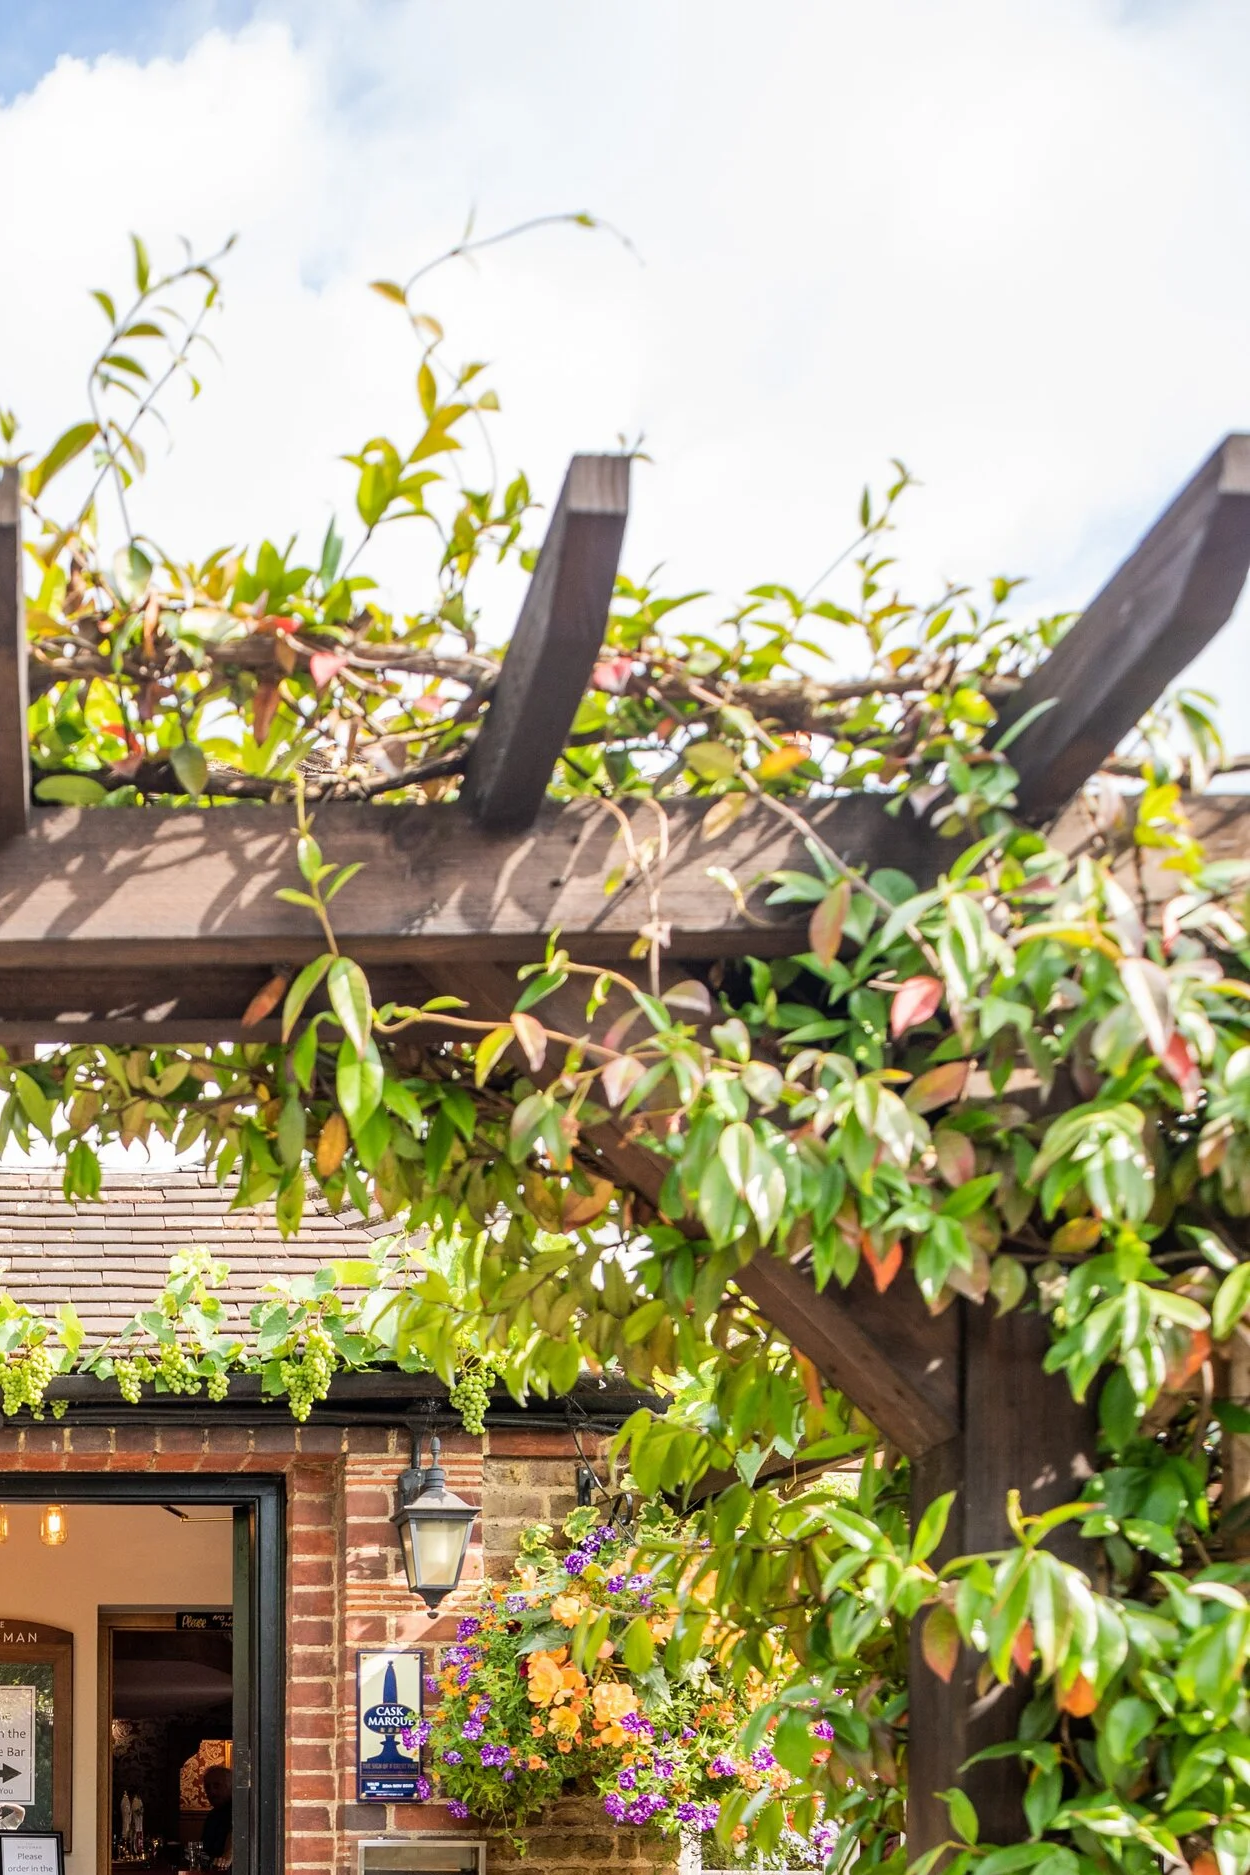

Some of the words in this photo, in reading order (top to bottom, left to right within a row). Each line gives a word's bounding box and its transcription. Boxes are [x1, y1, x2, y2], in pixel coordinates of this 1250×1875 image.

[375, 1706, 404, 1716] CASK
[368, 1716, 414, 1727] MARQUE
[7, 1728, 26, 1739] the
[7, 1747, 26, 1757] Bar
[0, 1787, 14, 1795] You
[40, 1865, 54, 1873] the
